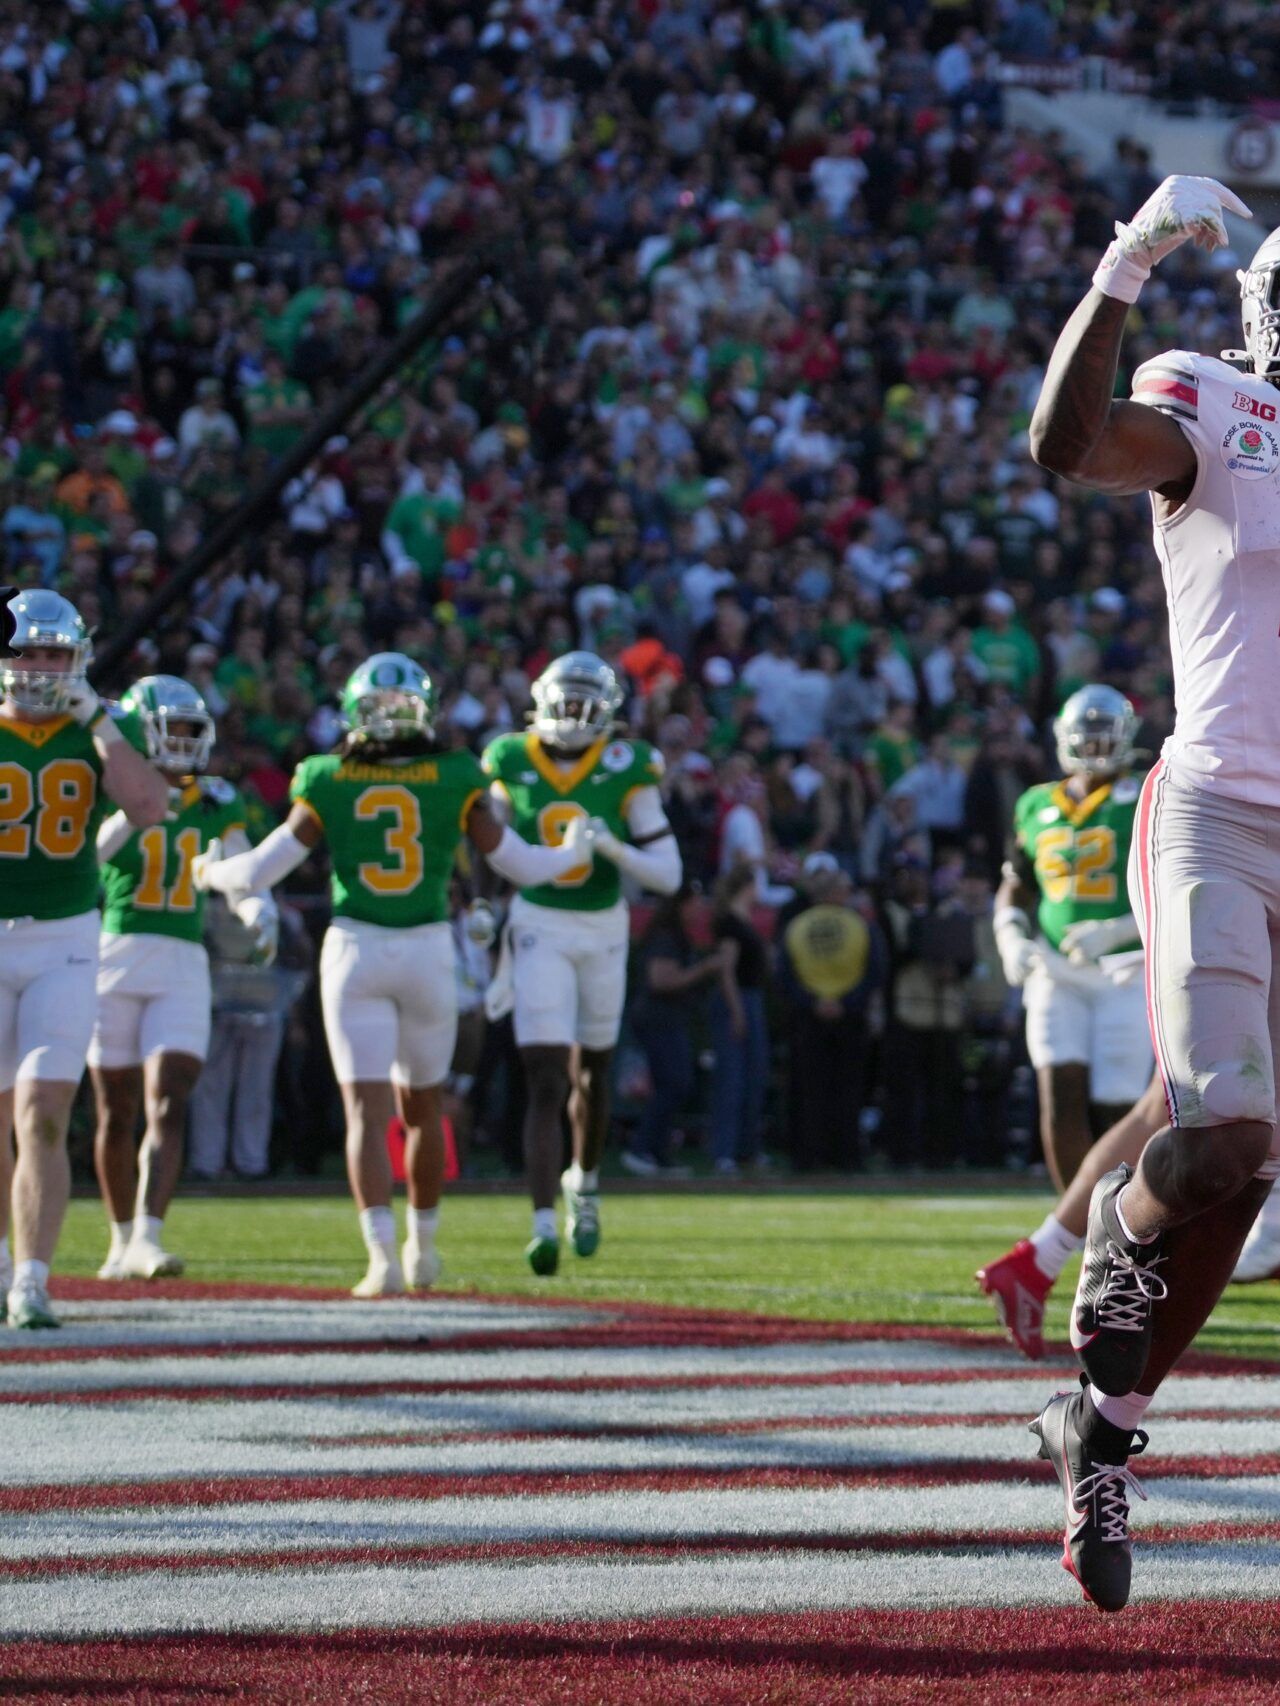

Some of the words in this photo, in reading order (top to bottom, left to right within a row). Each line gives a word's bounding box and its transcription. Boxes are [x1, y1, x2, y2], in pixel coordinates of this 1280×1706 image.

[1223, 425, 1239, 448] ROSE
[1239, 422, 1264, 433] BOWL
[1265, 431, 1278, 456] GAME
[1238, 462, 1270, 473] Prudential
[0, 759, 97, 859] 28
[355, 785, 424, 895] 3
[132, 825, 200, 911] 11
